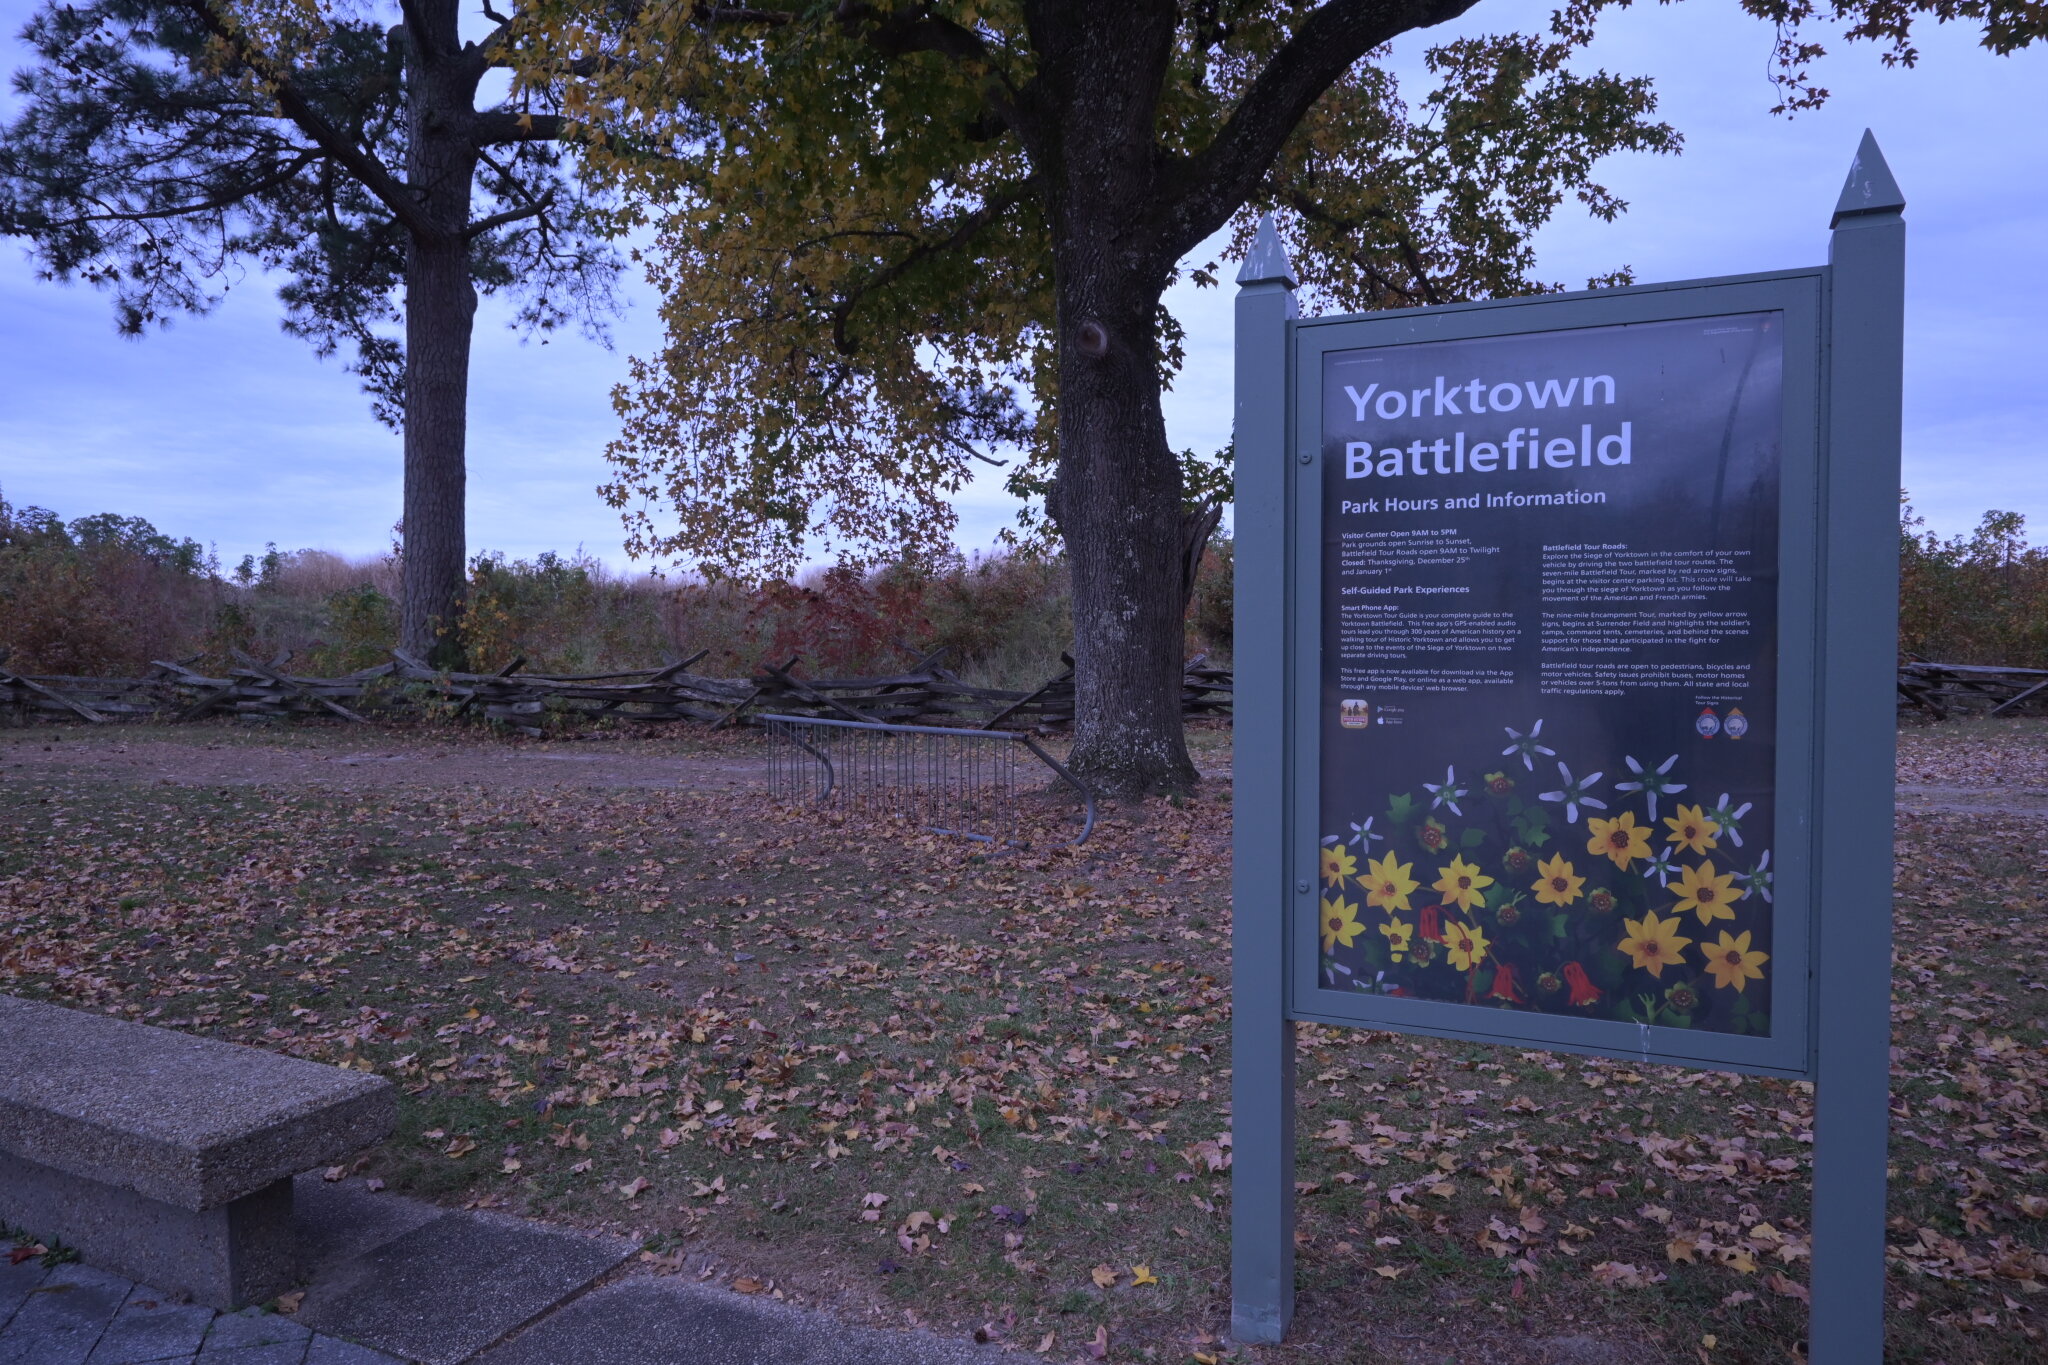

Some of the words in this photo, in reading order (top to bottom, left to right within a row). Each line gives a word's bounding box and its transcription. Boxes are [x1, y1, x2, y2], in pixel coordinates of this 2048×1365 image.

[1344, 374, 1615, 421] Yorktown
[1346, 422, 1631, 479] Battlefield
[1342, 498, 1378, 514] Park
[1385, 496, 1438, 511] Hours
[1445, 493, 1479, 509] and
[1487, 490, 1606, 507] Information
[1390, 530, 1409, 539] Open
[1358, 541, 1386, 549] grounds
[1470, 546, 1500, 555] Twilight
[1543, 553, 1568, 561] Explore
[1584, 552, 1602, 560] Siege
[1416, 586, 1470, 595] Experiences
[1563, 688, 1602, 696] regulations
